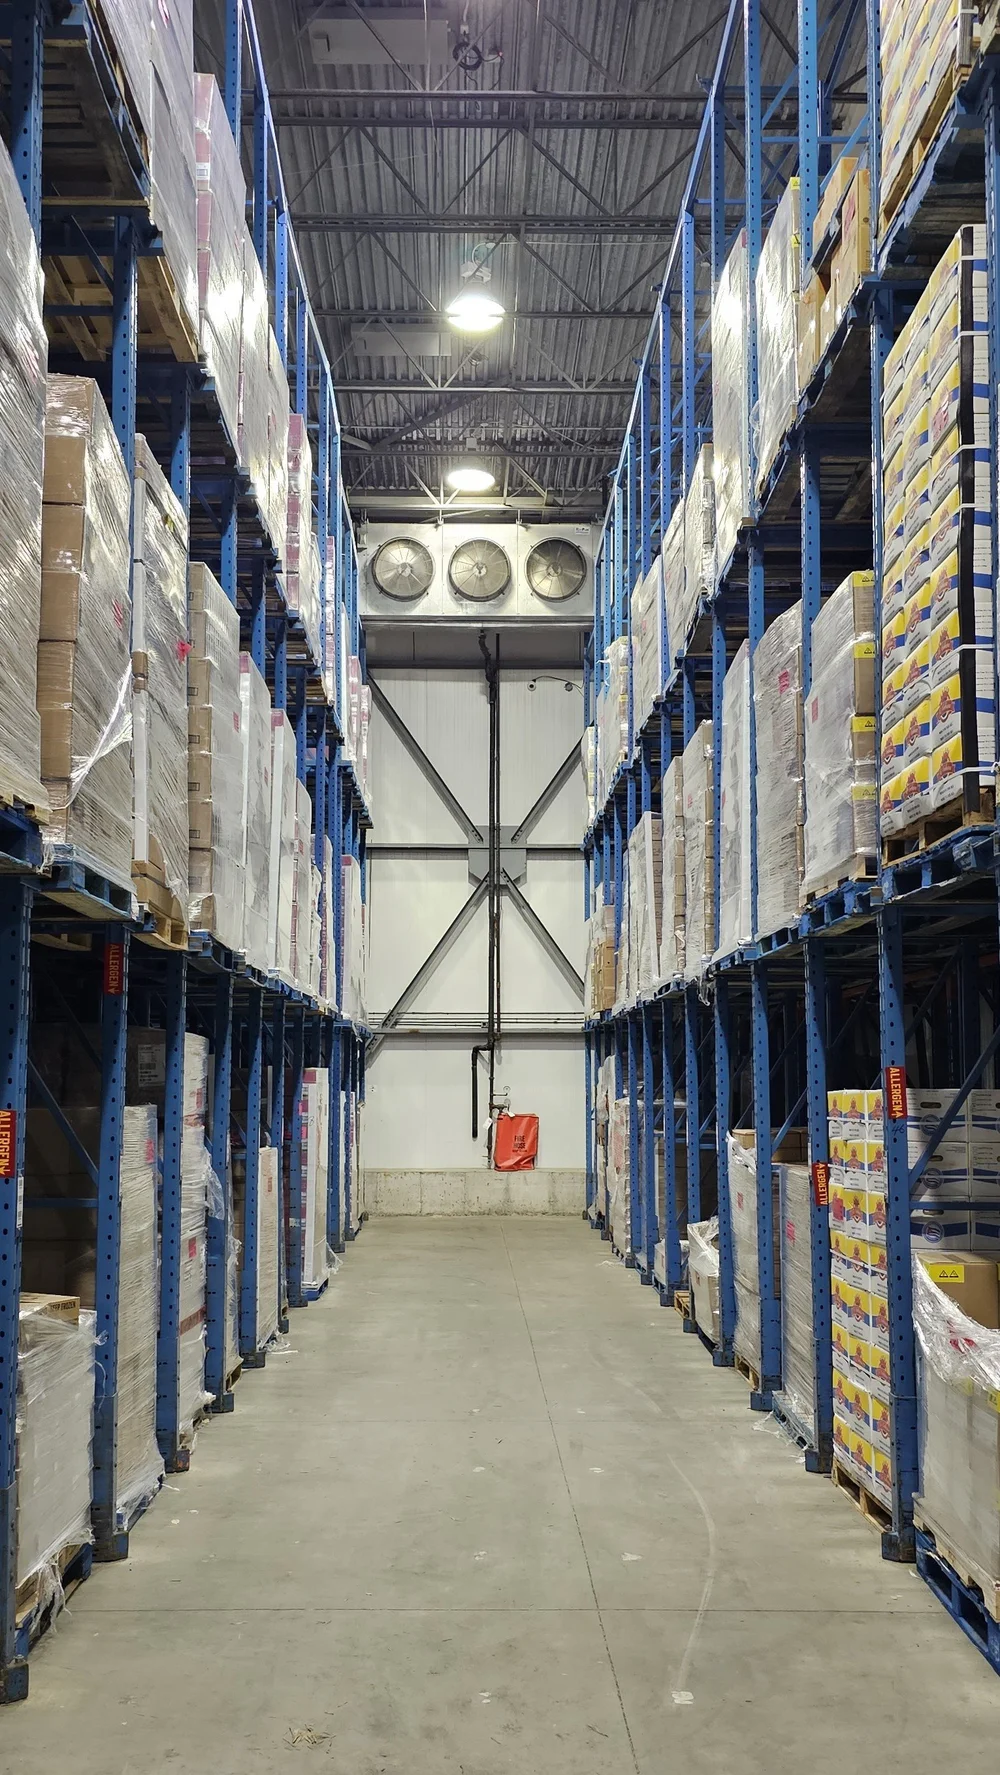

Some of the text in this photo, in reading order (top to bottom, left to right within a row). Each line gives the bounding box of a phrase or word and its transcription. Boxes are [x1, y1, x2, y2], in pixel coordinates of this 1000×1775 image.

[109, 944, 120, 987] ALLERGEN
[889, 1067, 903, 1111] ALLERGEN
[0, 1110, 11, 1166] ALLERGEN
[892, 1124, 905, 1136] 46
[816, 1169, 828, 1205] ALLERGEN
